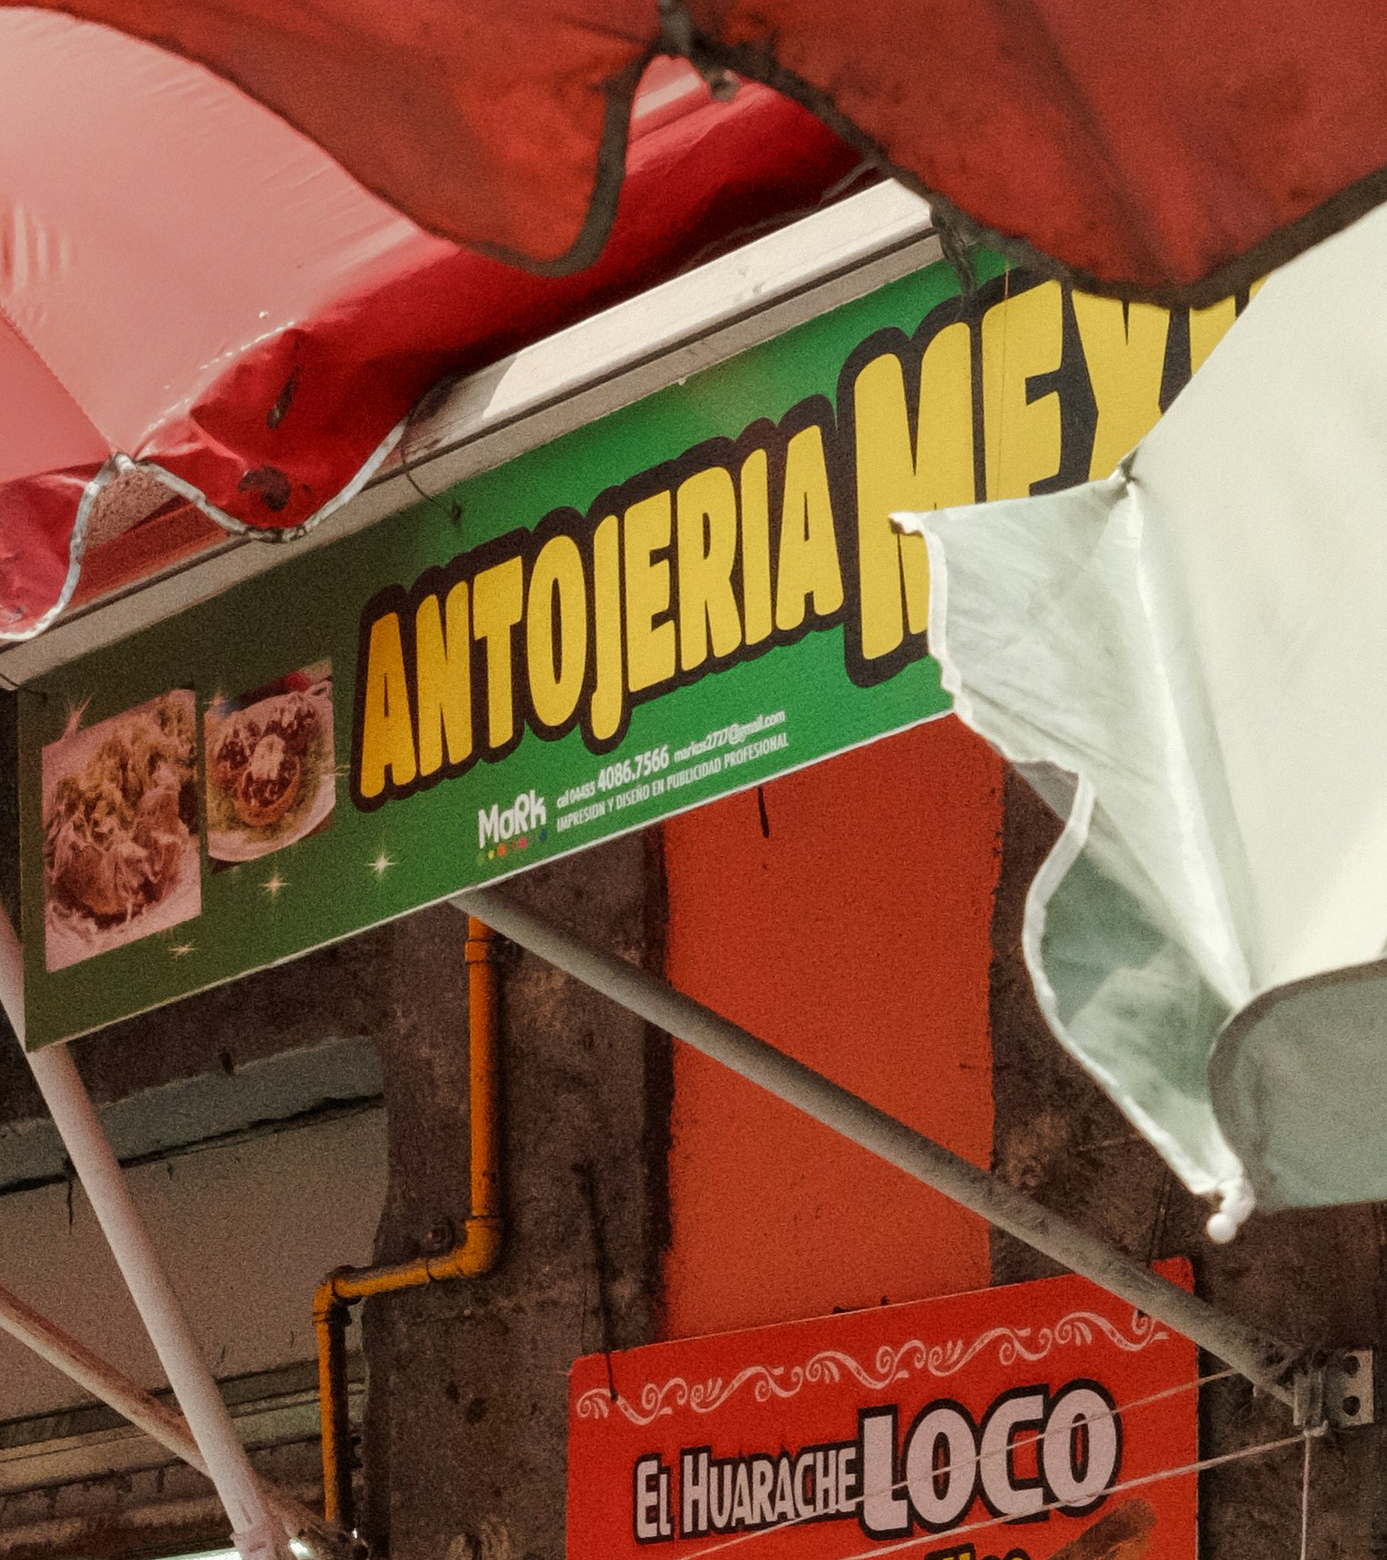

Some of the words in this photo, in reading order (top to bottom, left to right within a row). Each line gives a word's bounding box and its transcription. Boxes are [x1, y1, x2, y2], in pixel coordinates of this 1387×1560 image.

[357, 422, 847, 800] ANTOJERIA
[852, 273, 1269, 661] MEX
[597, 744, 670, 792] 4086.7566
[607, 796, 615, 813] Y
[616, 784, 651, 811] DISEÑO
[652, 779, 666, 797] EN
[667, 757, 722, 791] PUBLICIDAD
[724, 732, 789, 769] PROFESIONAL
[862, 1388, 1118, 1532] LOCO
